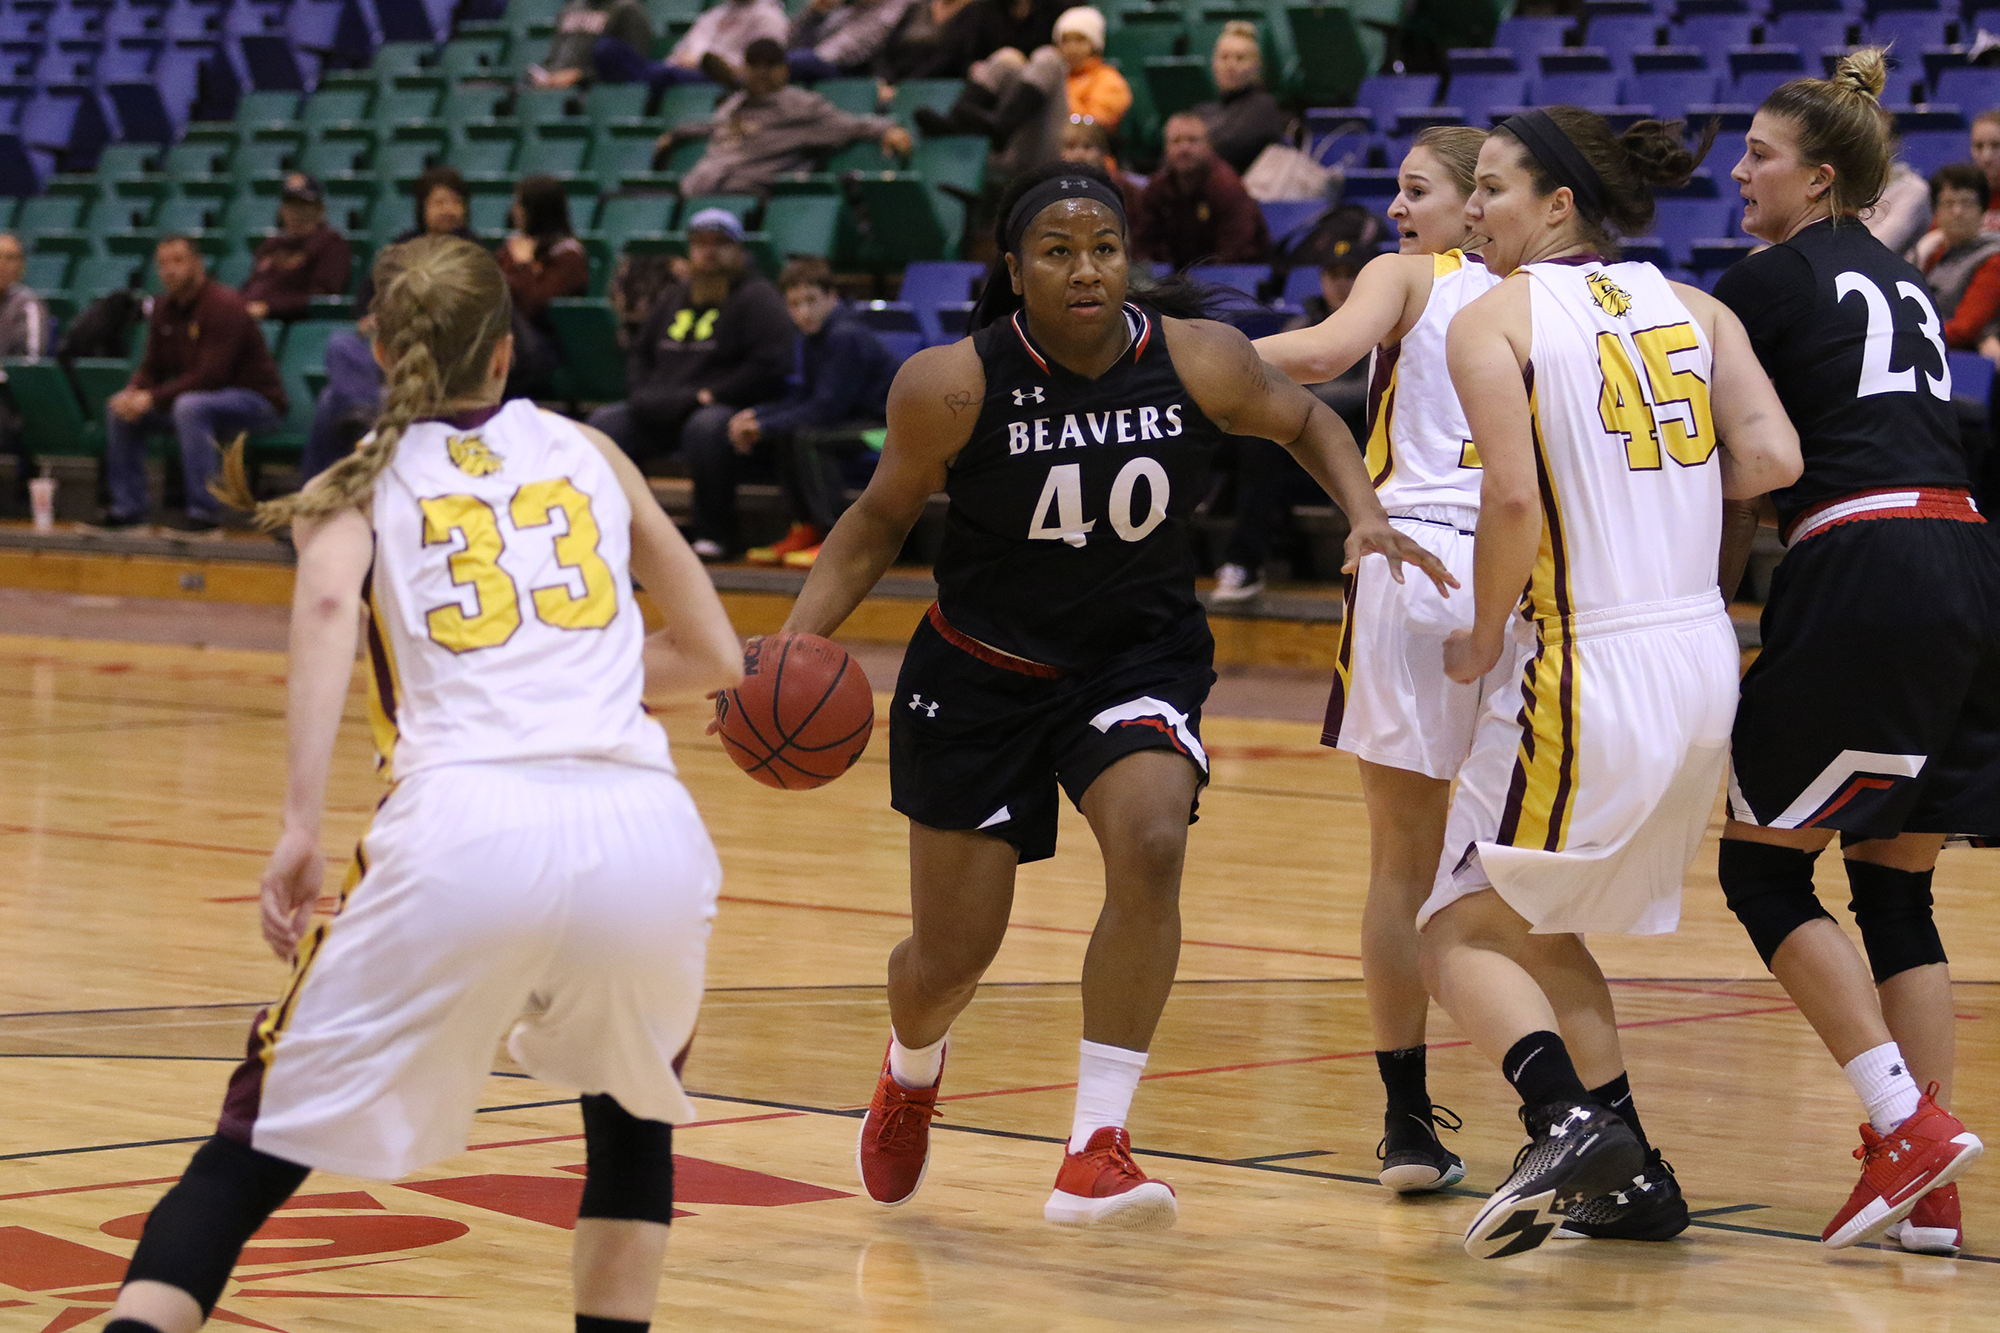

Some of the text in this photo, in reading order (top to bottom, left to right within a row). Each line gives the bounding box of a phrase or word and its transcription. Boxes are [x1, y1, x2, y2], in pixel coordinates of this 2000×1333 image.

[1596, 321, 1717, 471] 45
[1834, 270, 1952, 402] 23
[1007, 404, 1183, 456] BEAVERS
[418, 476, 619, 656] 33
[1027, 456, 1170, 548] 40
